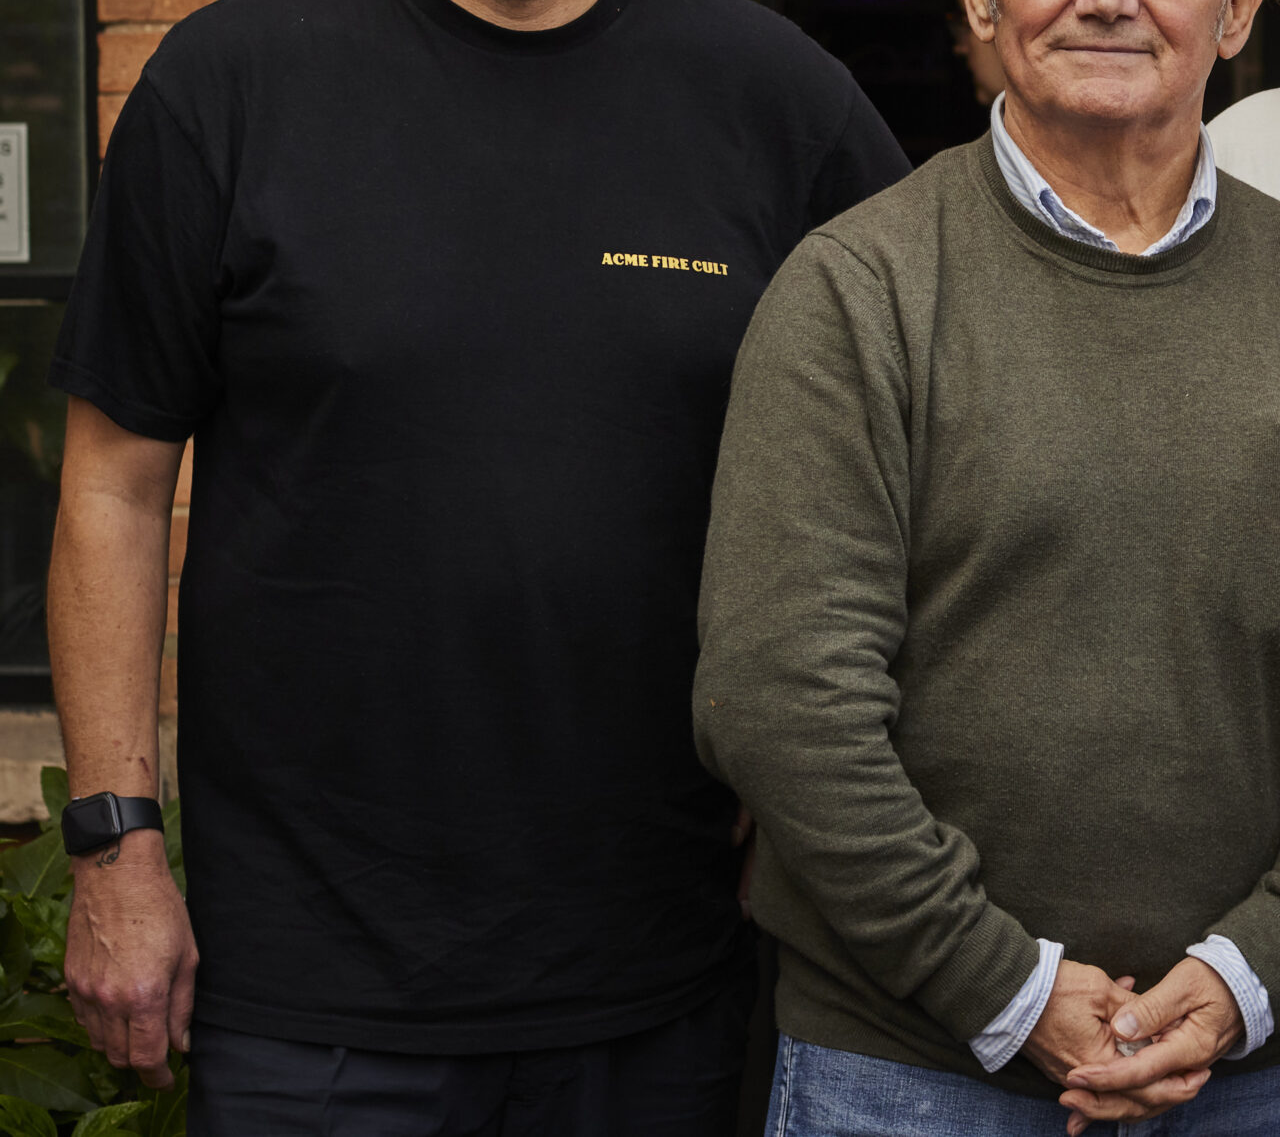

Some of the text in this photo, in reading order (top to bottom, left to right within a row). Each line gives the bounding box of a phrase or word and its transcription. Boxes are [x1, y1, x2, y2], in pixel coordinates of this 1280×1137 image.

[601, 252, 729, 276] ACME FIRE CULT
